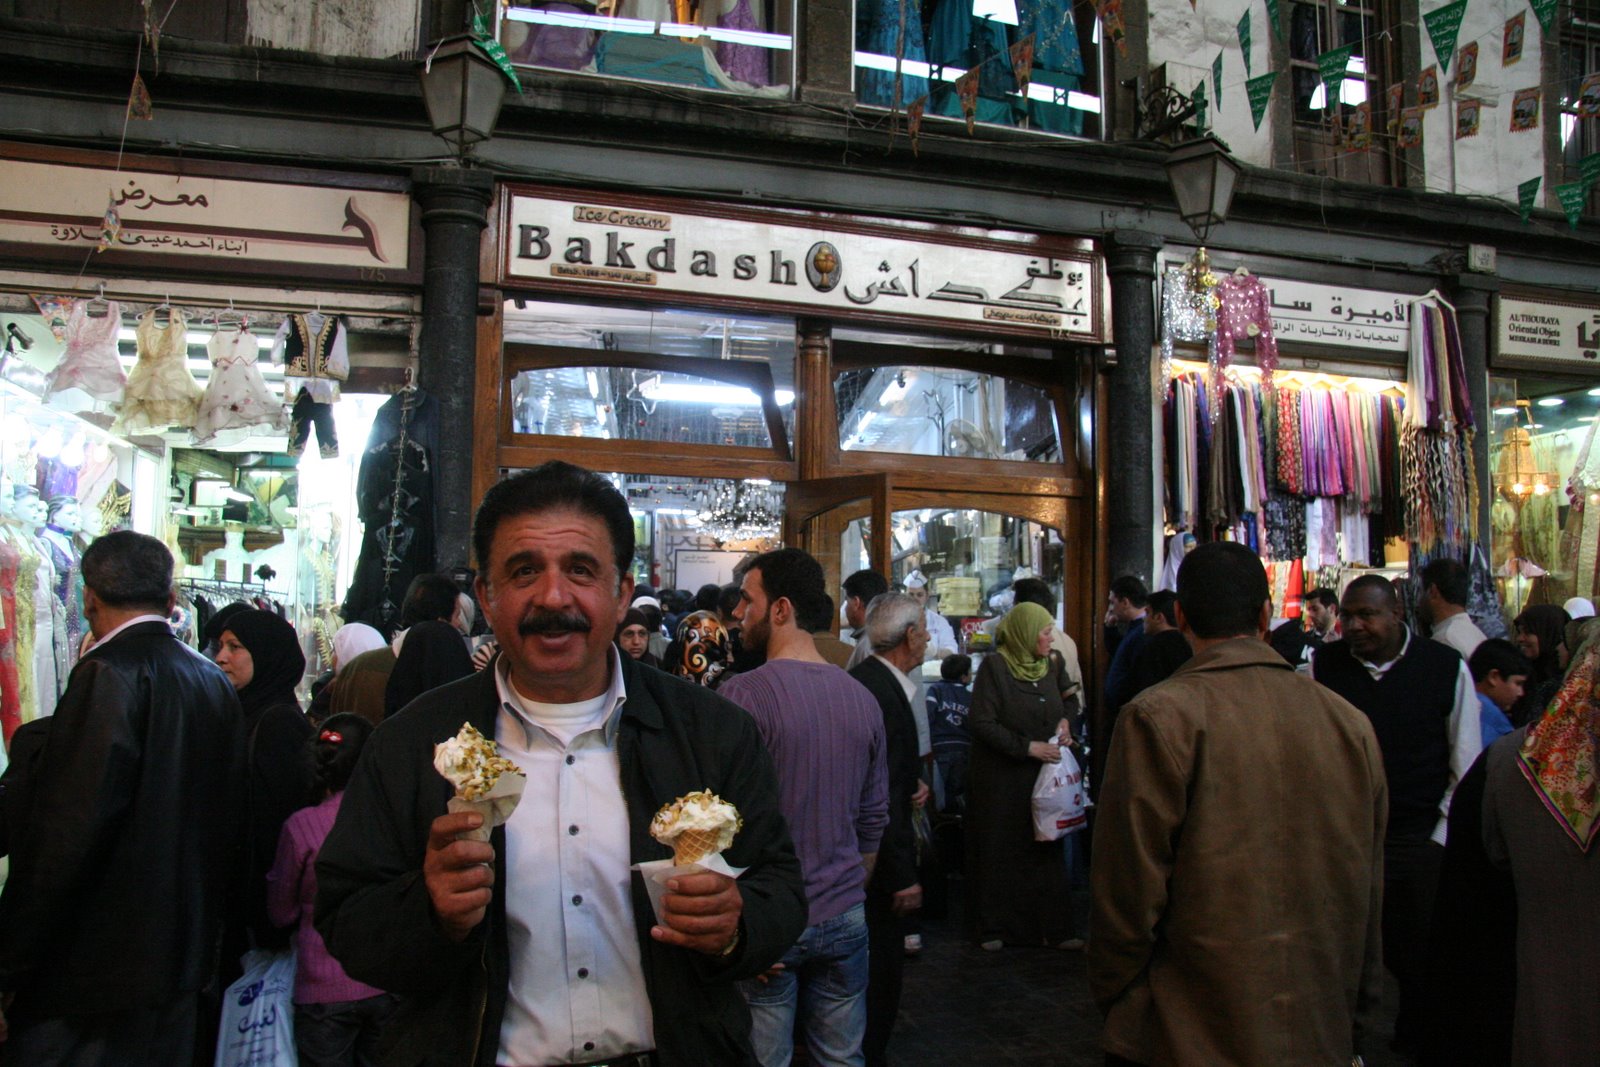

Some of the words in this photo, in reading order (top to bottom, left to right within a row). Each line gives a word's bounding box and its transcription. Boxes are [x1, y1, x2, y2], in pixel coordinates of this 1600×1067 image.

[116, 180, 208, 209] معرض
[577, 207, 605, 221] Ice
[608, 211, 668, 229] Cream
[517, 223, 797, 286] Bakdash
[843, 258, 1088, 326] بكداش
[1508, 323, 1538, 335] Oriental
[1509, 313, 1520, 322] AL
[1520, 314, 1560, 326] THOURAYA
